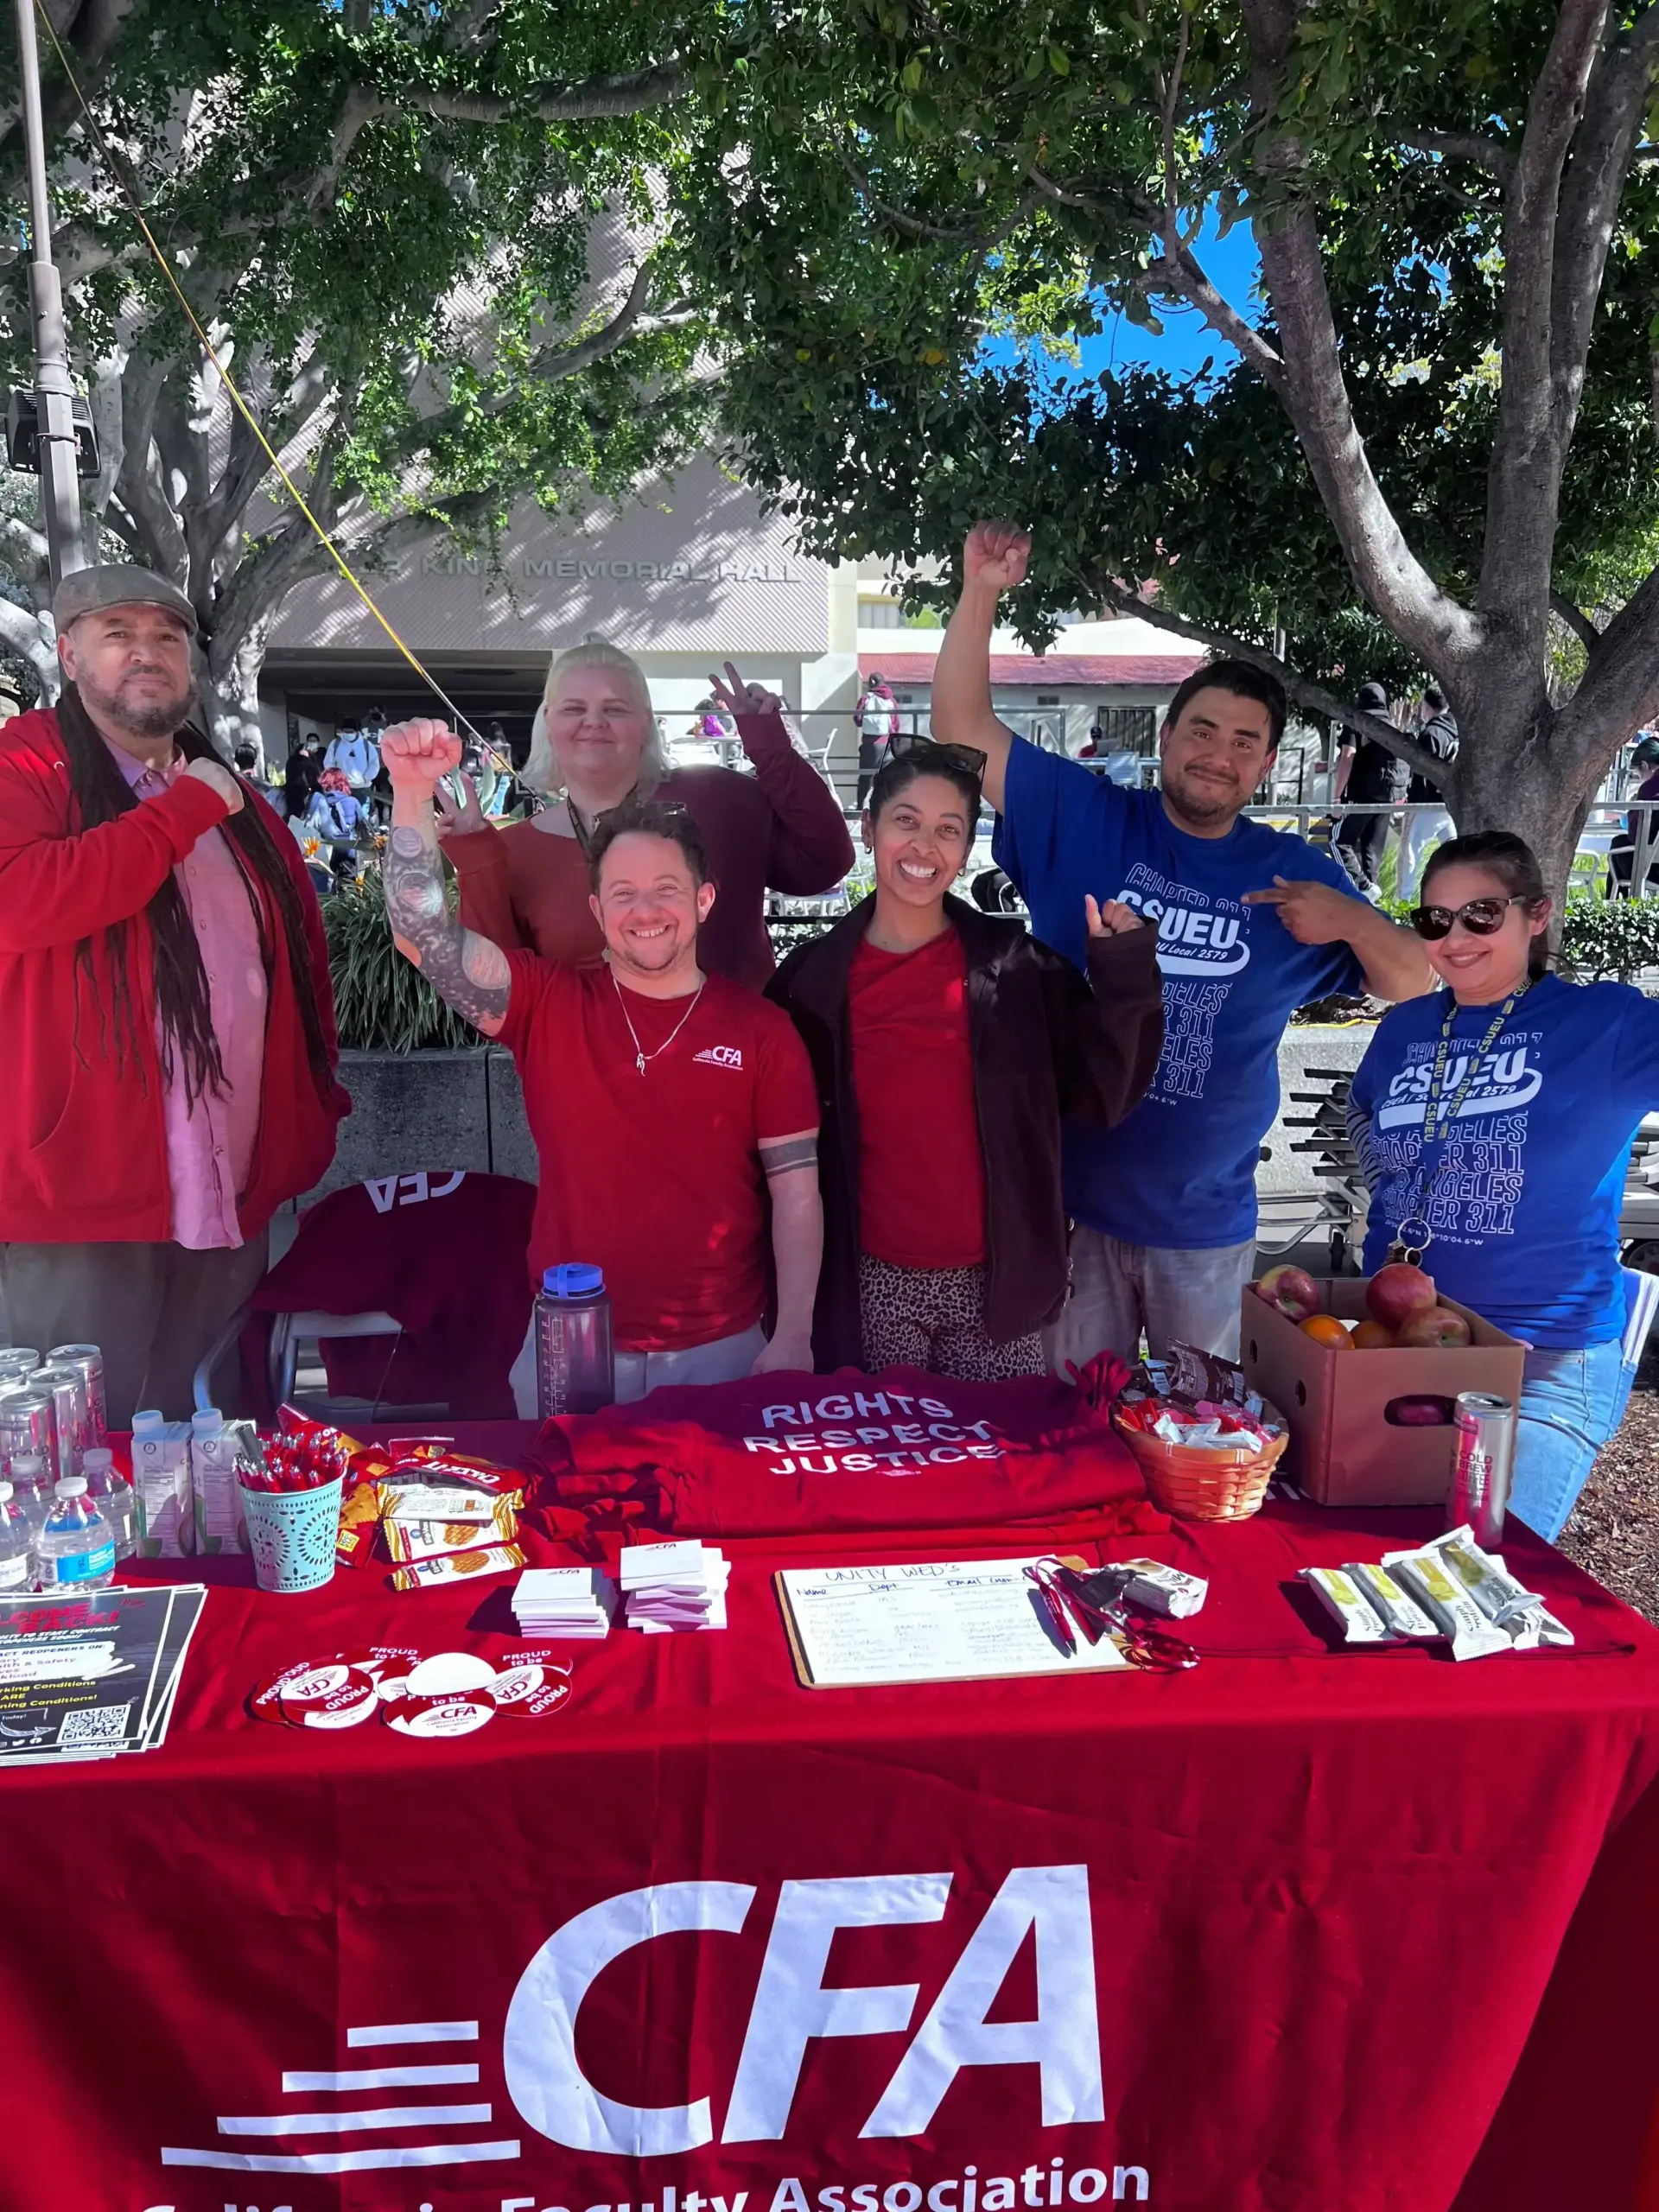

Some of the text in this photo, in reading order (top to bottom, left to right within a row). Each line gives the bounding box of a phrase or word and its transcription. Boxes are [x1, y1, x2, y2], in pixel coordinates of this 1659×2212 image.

[523, 558, 707, 581] MEMORIAL
[721, 561, 804, 582] HALL
[1168, 943, 1198, 957] Local
[1198, 949, 1229, 961] 2579
[1176, 1006, 1215, 1044] 311
[1478, 1015, 1505, 1054] CSUEU
[712, 1046, 742, 1066] CFA
[1160, 1031, 1213, 1071] ELES
[1433, 1040, 1448, 1078] CSUEU
[1163, 1063, 1205, 1099] 311
[1481, 1084, 1517, 1097] 2579
[1446, 1077, 1471, 1117] CSUEU
[1423, 1102, 1438, 1143] CSUEU
[1472, 1141, 1525, 1176] 311
[1465, 1201, 1515, 1235] 311
[761, 1391, 955, 1428] RIGHTS
[742, 1420, 993, 1453] RESPECT
[768, 1443, 1007, 1475] JUSTICE
[1459, 1450, 1493, 1465] COLD
[825, 1567, 887, 1582] UNITY
[796, 1587, 827, 1597] Name
[868, 1581, 899, 1593] Dept
[17, 1611, 120, 1635] BACK!
[69, 1625, 121, 1635] CONTRACT
[22, 1645, 85, 1656] REOPENERS
[369, 1647, 418, 1656] PROUD
[502, 1649, 552, 1662] PROUD
[33, 1680, 97, 1691] Conditions
[255, 1676, 292, 1706] PROUD
[296, 1678, 331, 1697] CFA
[325, 1685, 370, 1710] PROUD
[496, 1681, 529, 1700] CFA
[29, 1694, 98, 1707] Conditions!
[432, 1698, 446, 1707] to
[529, 1684, 569, 1714] PROUD
[441, 1706, 478, 1719] CFA
[503, 1863, 1105, 2158] CFA
[767, 2157, 1150, 2212] Association
